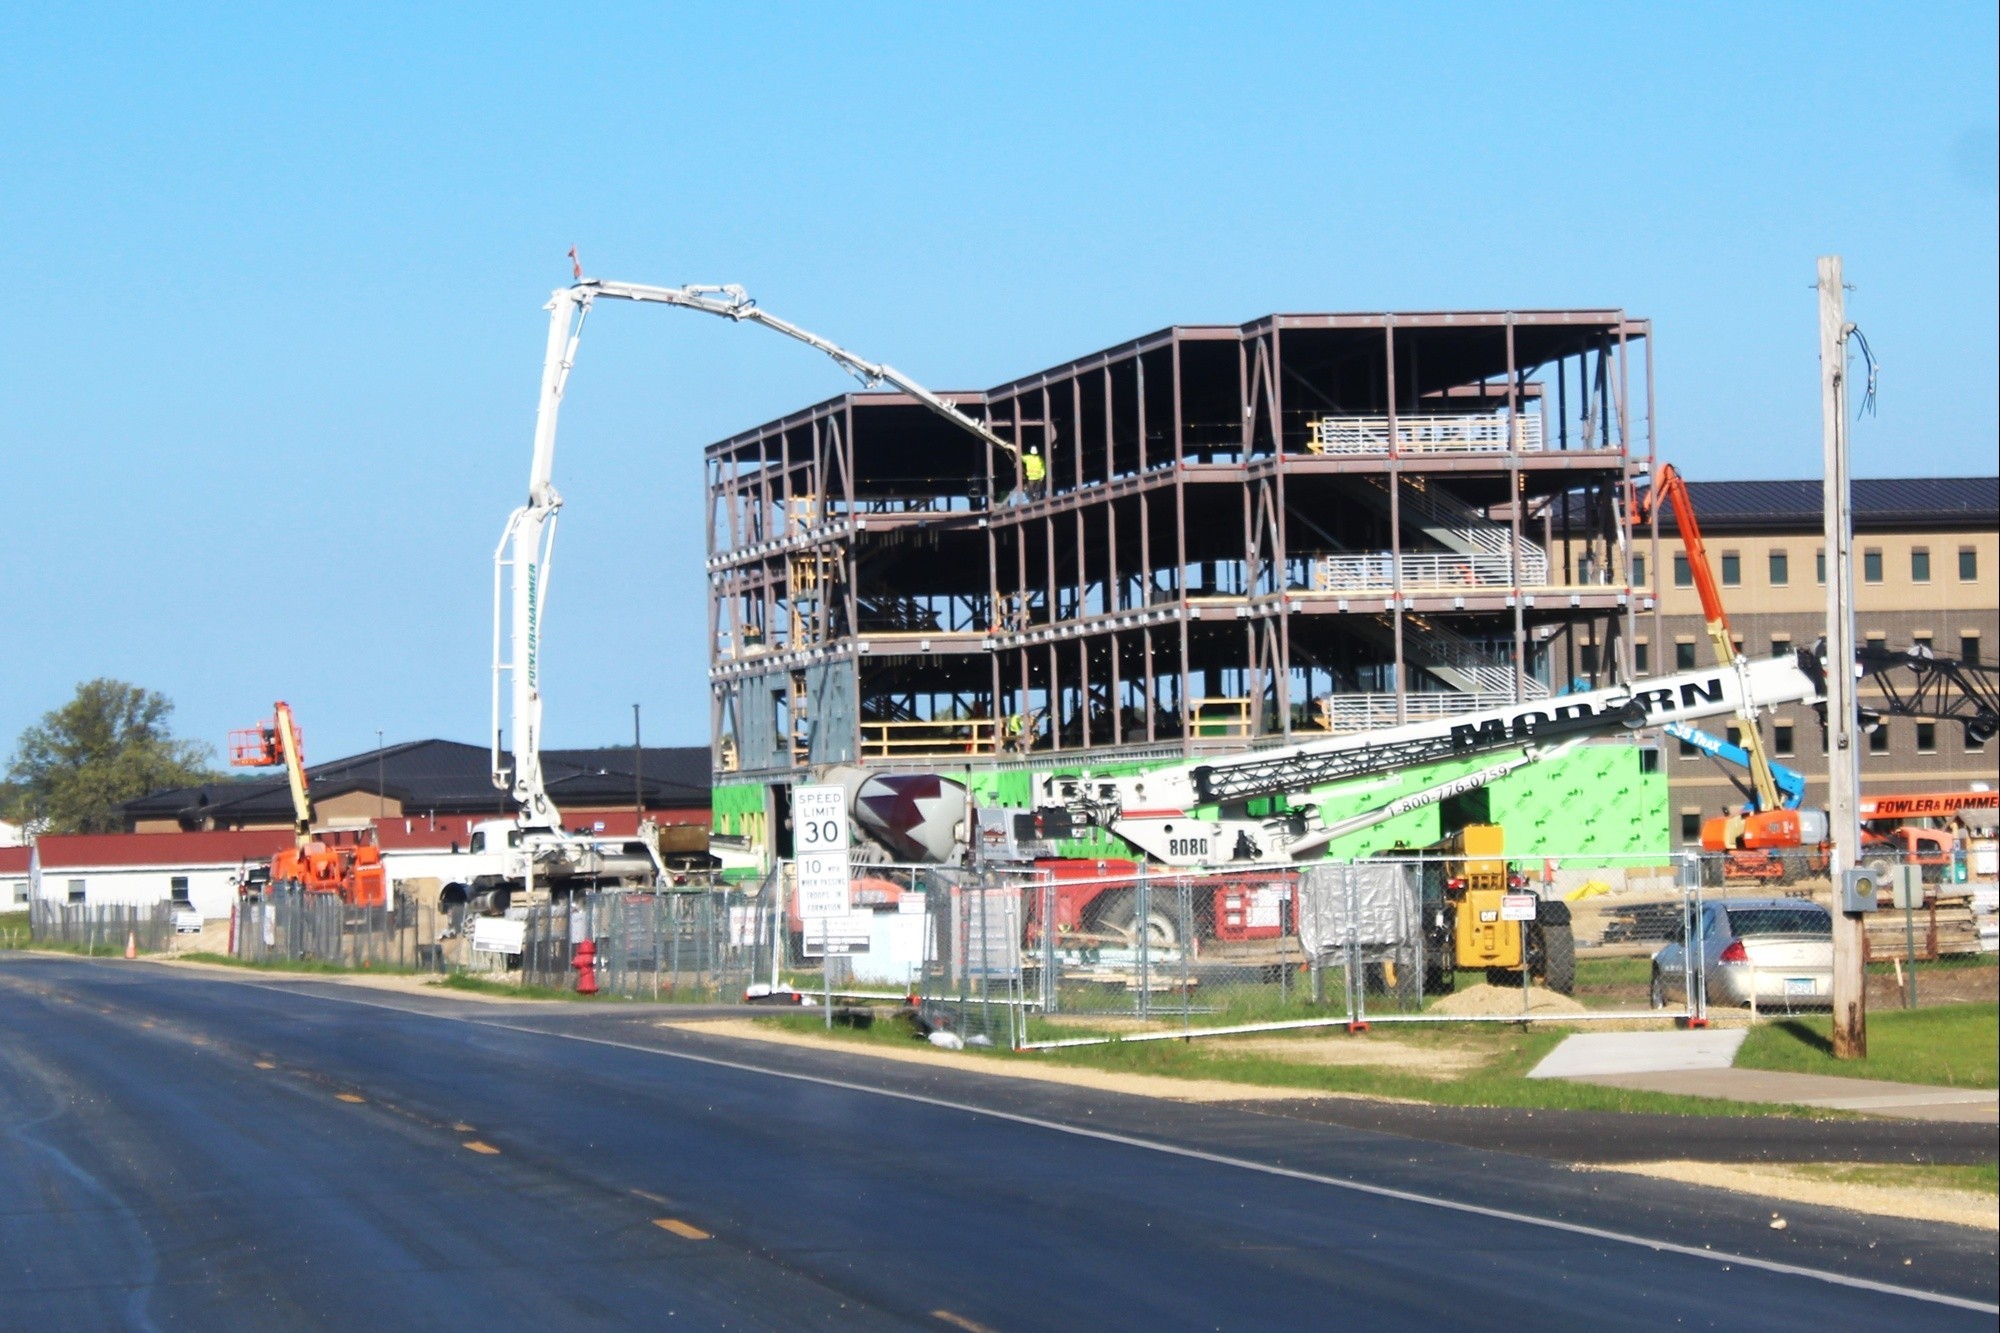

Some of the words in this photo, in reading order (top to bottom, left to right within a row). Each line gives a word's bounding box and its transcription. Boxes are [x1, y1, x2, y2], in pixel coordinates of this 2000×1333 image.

[1450, 678, 1724, 750] MODRN
[798, 793, 841, 804] SPEED
[1388, 765, 1508, 818] 1-800-776-0759
[1943, 796, 1998, 811] HAMME
[803, 806, 836, 818] LIMIT
[804, 820, 838, 844] 30
[1169, 838, 1208, 856] 8080
[805, 860, 822, 874] 10
